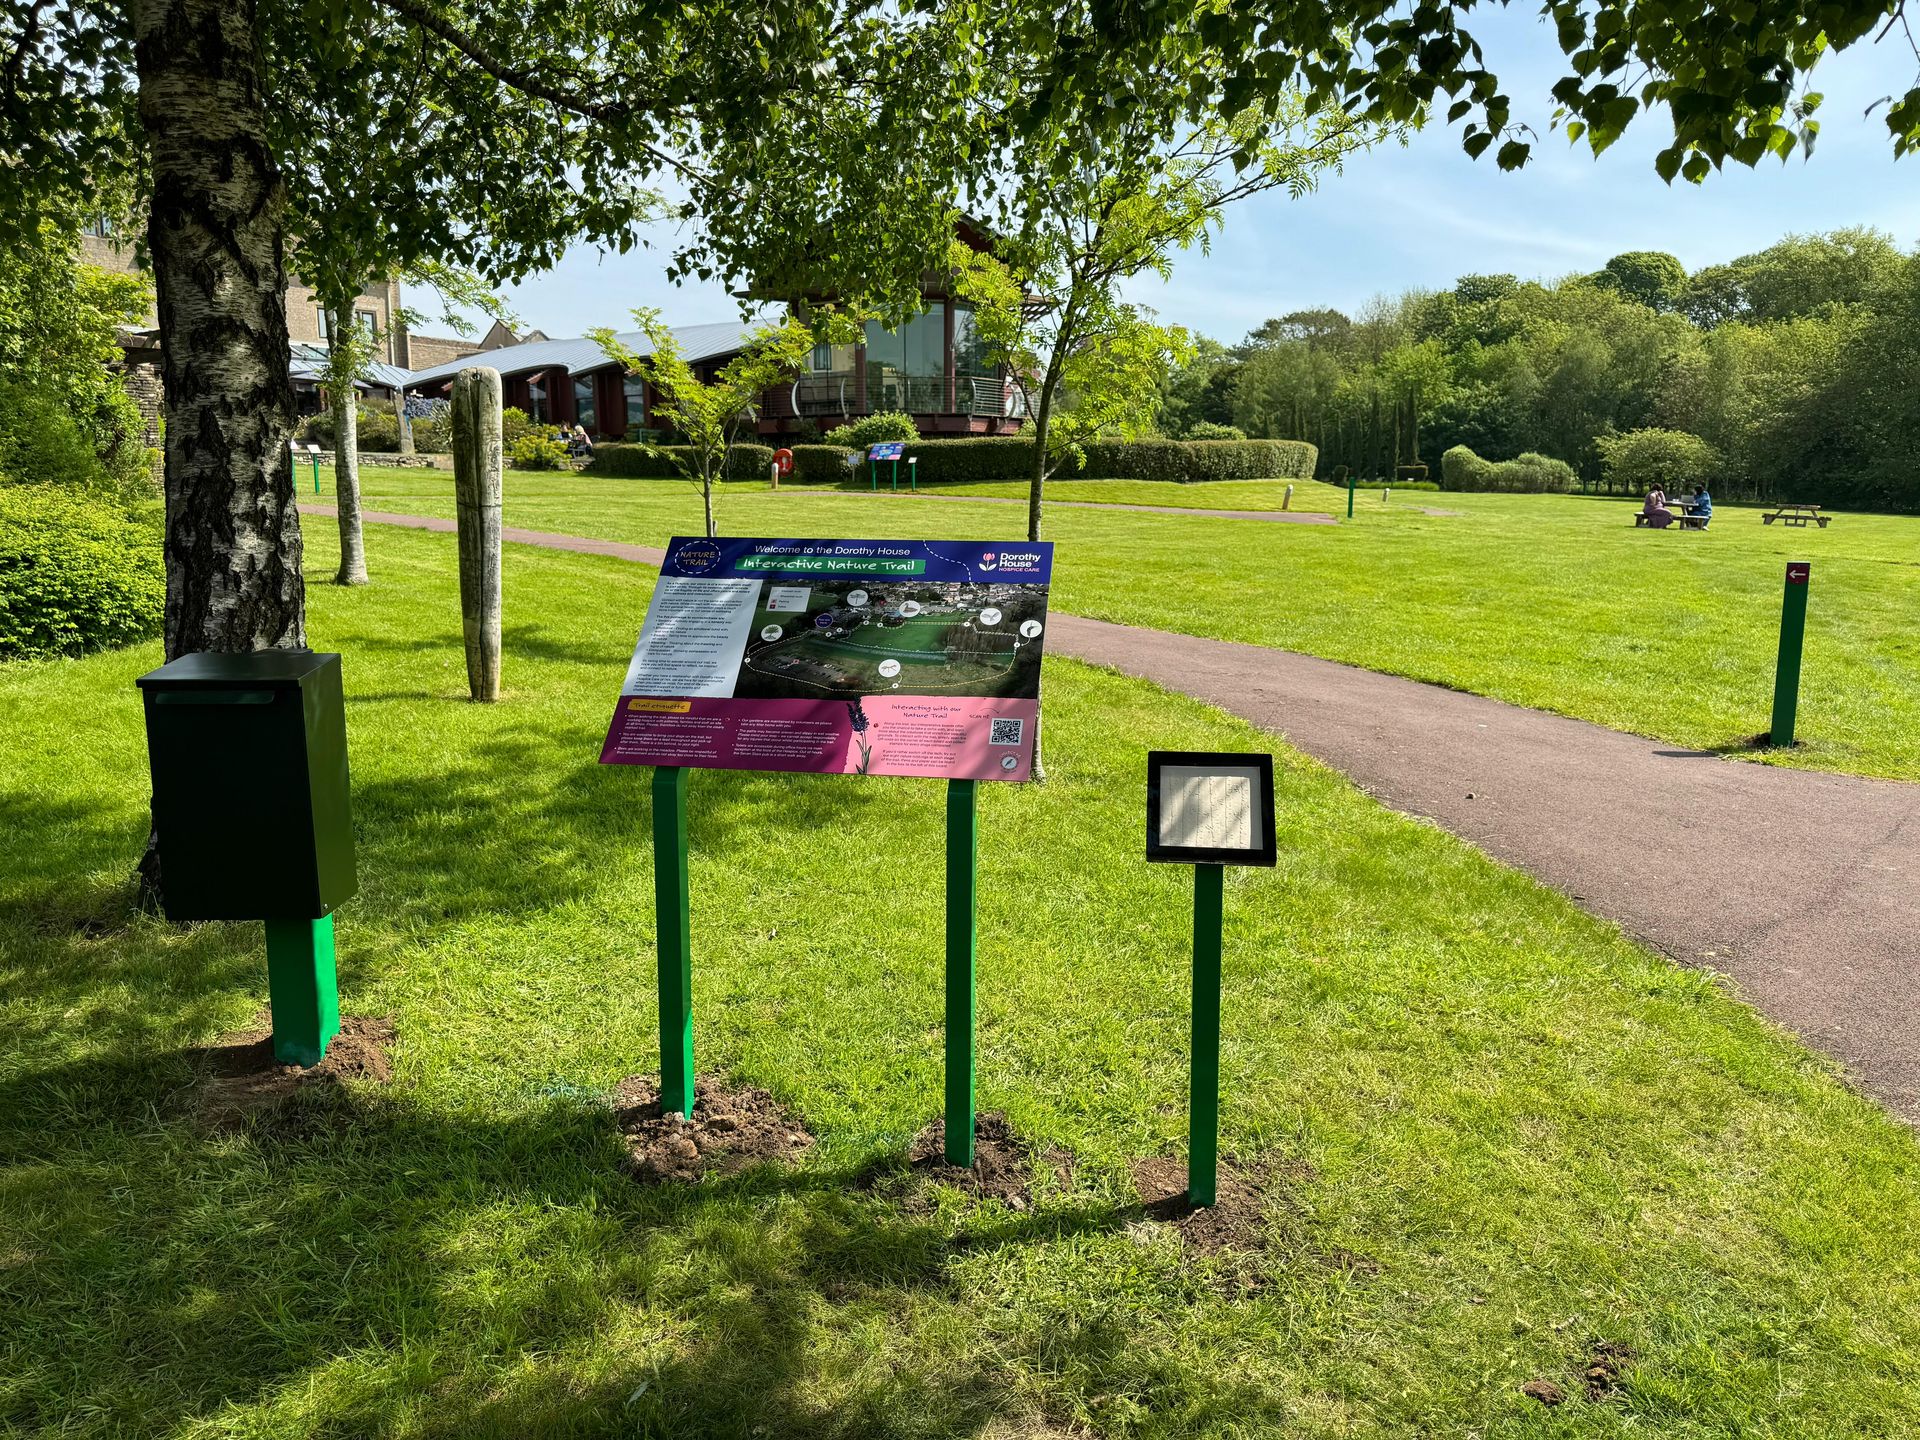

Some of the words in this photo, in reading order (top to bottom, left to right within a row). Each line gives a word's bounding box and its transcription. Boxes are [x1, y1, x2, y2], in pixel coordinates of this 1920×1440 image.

[755, 545, 800, 554] Welcome
[804, 546, 814, 554] to
[816, 546, 832, 554] the
[835, 546, 875, 557] Dorothy
[877, 547, 911, 555] House
[1000, 552, 1041, 562] Dorothy
[743, 558, 823, 569] Interactive
[827, 560, 877, 570] Nature
[881, 560, 915, 571] Trail
[891, 704, 931, 712] Interacting
